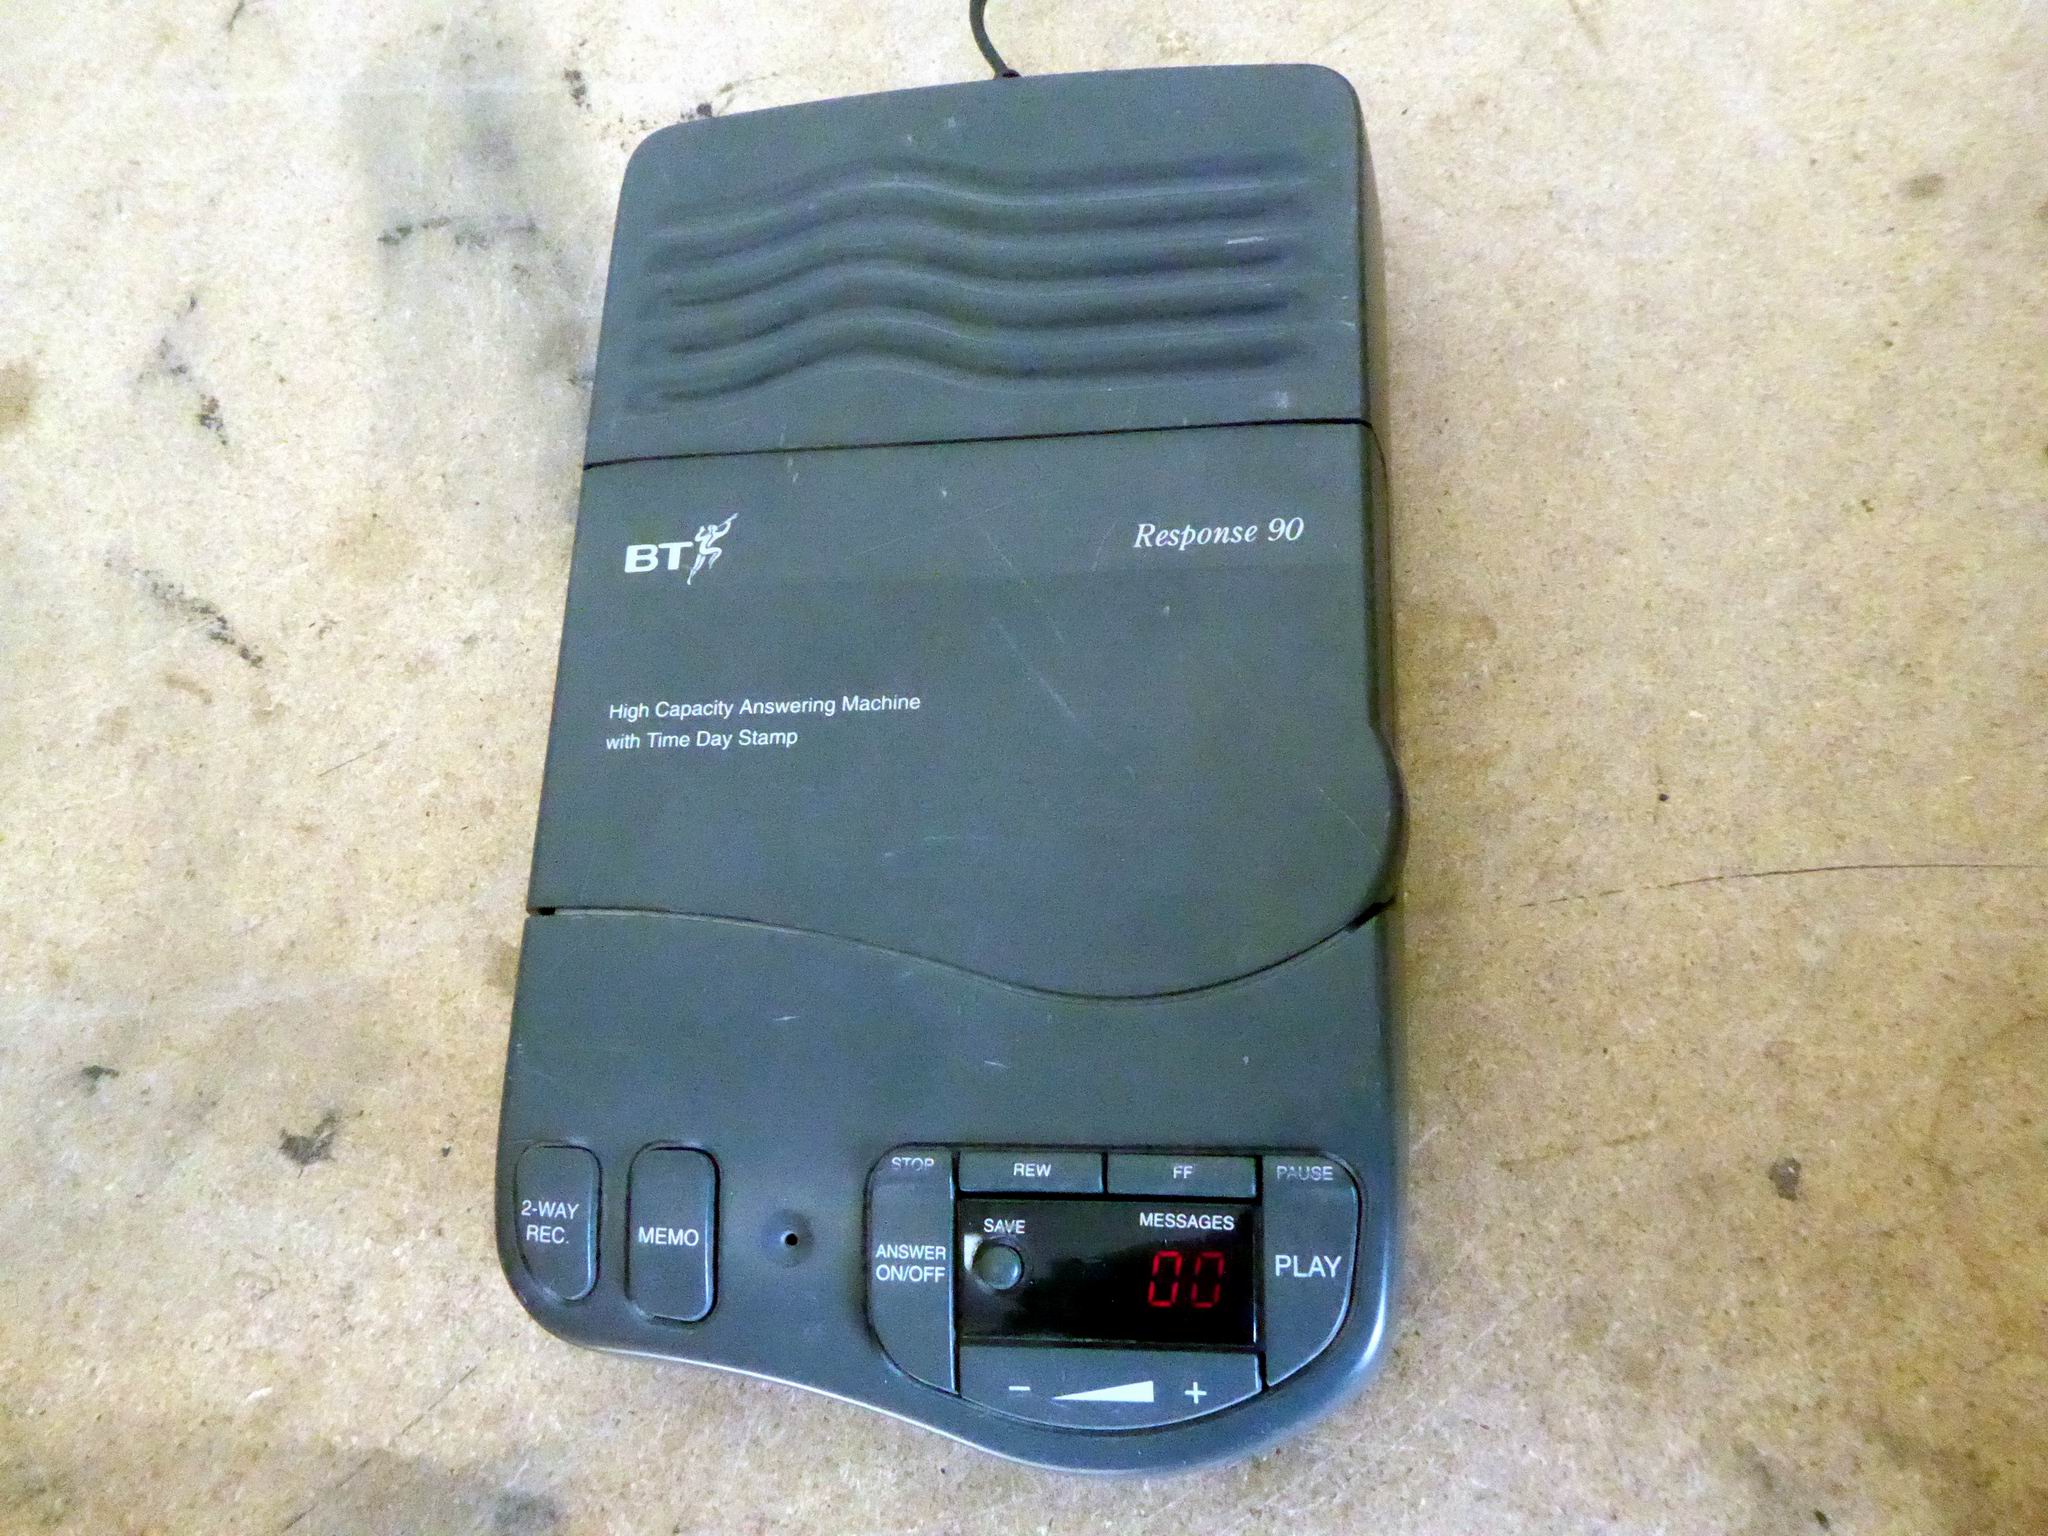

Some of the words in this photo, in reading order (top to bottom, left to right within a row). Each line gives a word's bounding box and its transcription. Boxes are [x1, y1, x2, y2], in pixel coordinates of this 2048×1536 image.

[1133, 523, 1258, 551] Response
[1267, 517, 1305, 542] 90
[624, 541, 694, 573] BT
[609, 703, 650, 722] High
[655, 700, 734, 720] Capacity
[739, 696, 836, 717] Answering
[842, 695, 921, 712] Machine
[606, 733, 641, 750] with
[647, 732, 691, 748] Time
[696, 731, 733, 750] Day
[738, 729, 799, 749] Stamp
[891, 1156, 935, 1171] STOP
[1013, 1162, 1052, 1177] REW
[1172, 1165, 1194, 1179] FF
[1276, 1165, 1334, 1181] PAUSE
[521, 1200, 580, 1219] 2-WAY
[983, 1218, 1026, 1234] SAVE
[1139, 1212, 1235, 1231] MESSAGES
[638, 1226, 700, 1247] MEMO
[875, 1244, 947, 1261] ANSWER
[875, 1265, 946, 1283] ON/OFF
[1275, 1254, 1342, 1278] PLAY
[1148, 1250, 1225, 1309] 00
